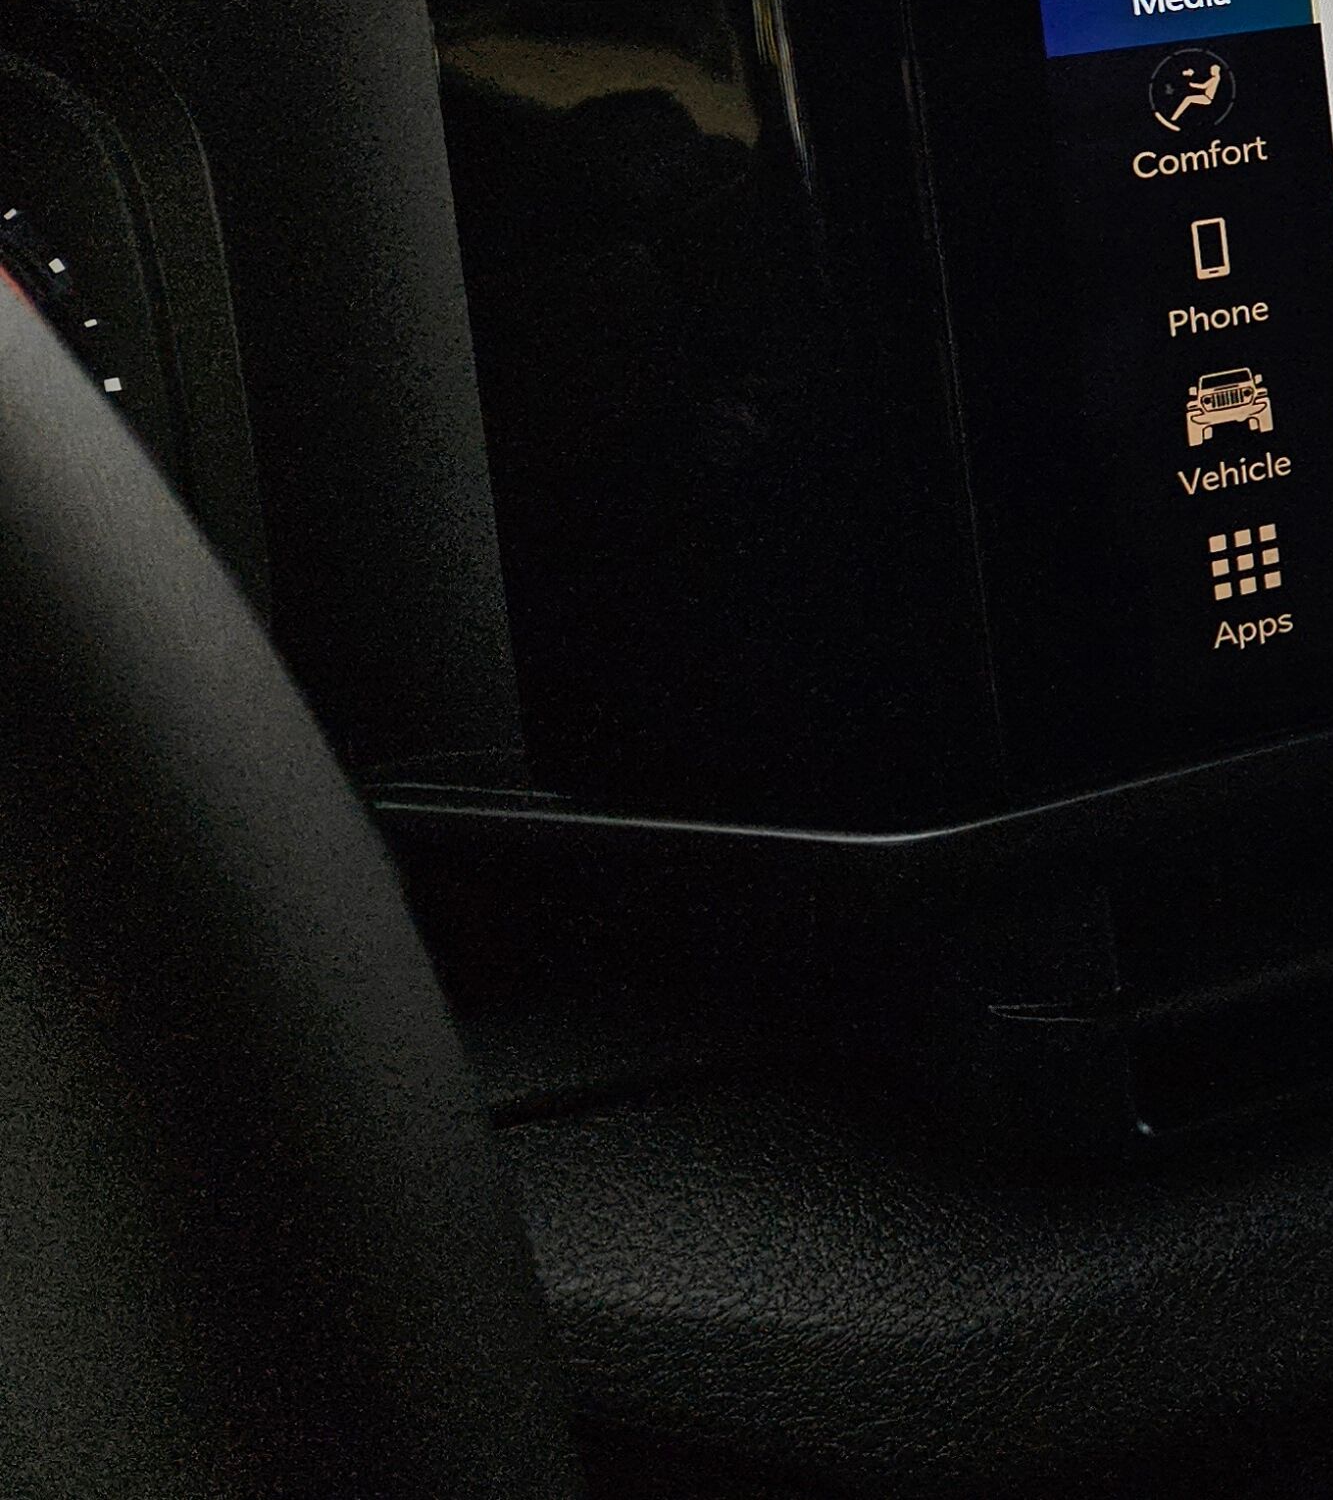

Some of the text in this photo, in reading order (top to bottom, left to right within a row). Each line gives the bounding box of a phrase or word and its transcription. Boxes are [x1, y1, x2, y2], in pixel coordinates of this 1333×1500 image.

[1132, 134, 1269, 180] Comfort
[1167, 300, 1270, 338] Phone
[1177, 450, 1292, 497] Vehicle
[1213, 612, 1294, 652] Apps
